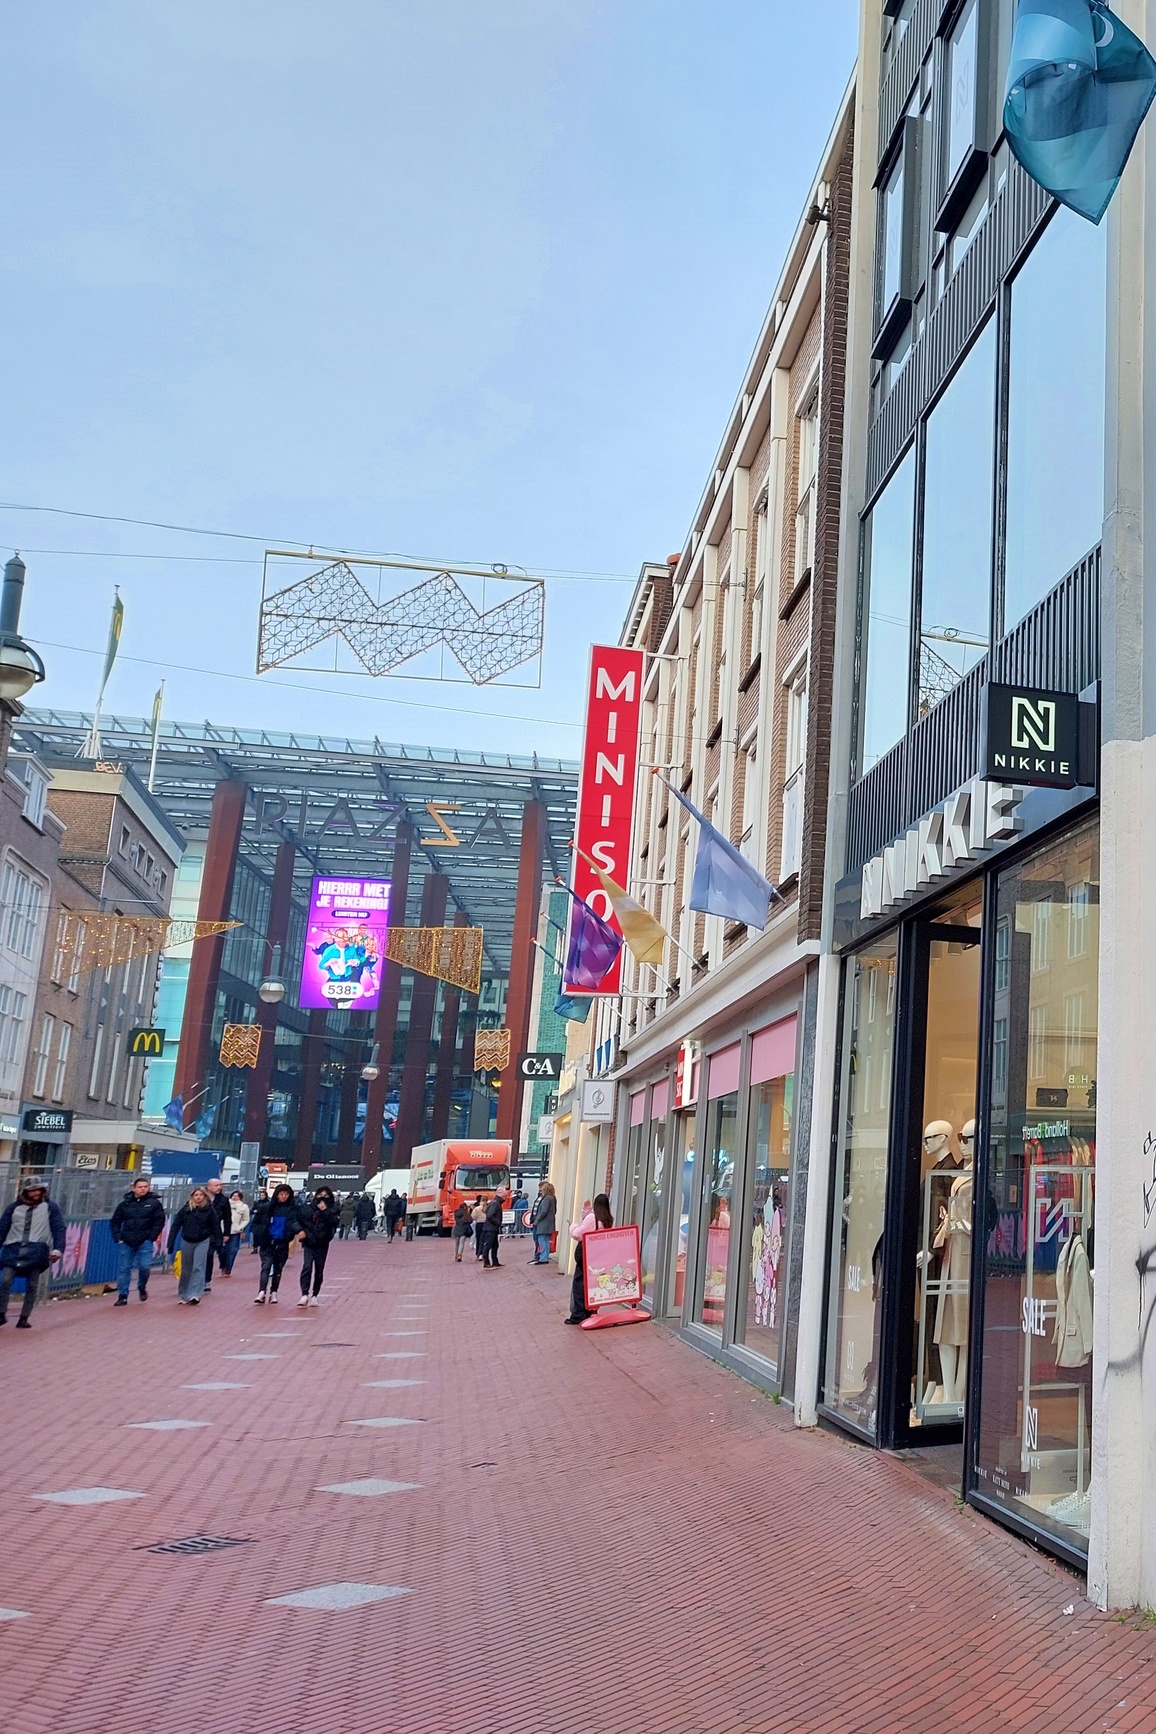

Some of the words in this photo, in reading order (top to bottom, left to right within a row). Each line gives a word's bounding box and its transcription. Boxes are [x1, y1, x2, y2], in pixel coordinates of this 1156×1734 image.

[994, 753, 1070, 775] NIKKIE
[584, 667, 635, 923] MINISO
[252, 792, 511, 850] PIAZZA
[318, 881, 361, 896] HIERRR
[363, 883, 392, 897] MET
[316, 895, 331, 908] JE
[334, 898, 389, 911] REKENING!
[327, 985, 352, 996] 538
[521, 1058, 555, 1076] C&A
[34, 1115, 66, 1126] SIEBEL
[78, 1155, 97, 1165] Etos
[848, 1265, 861, 1293] SALE
[1022, 1296, 1047, 1337] SALE
